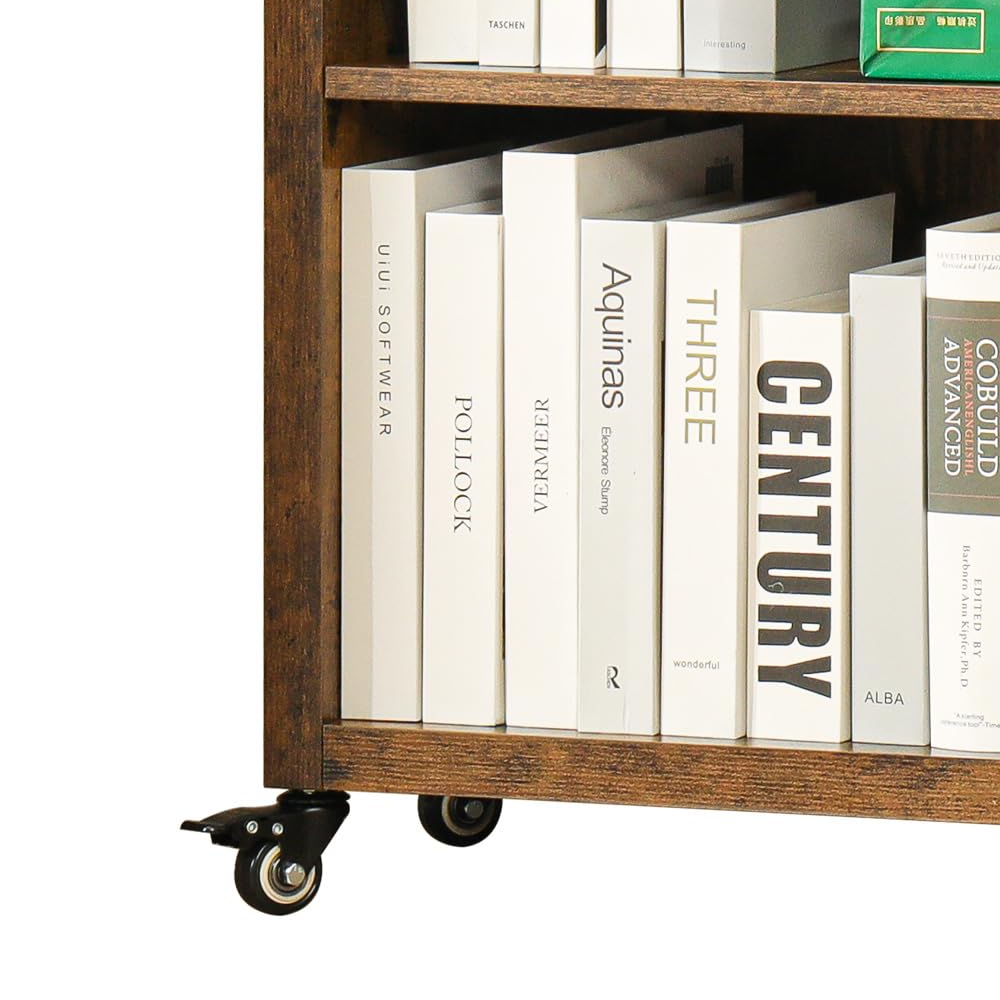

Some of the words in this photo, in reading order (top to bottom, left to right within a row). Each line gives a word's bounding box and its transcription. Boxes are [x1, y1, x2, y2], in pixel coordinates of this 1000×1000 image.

[488, 20, 525, 30] TASCHEN
[378, 244, 391, 291] UiUi
[378, 305, 392, 436] SOFTWEAR
[594, 262, 632, 409] Aquinas
[683, 289, 718, 445] THREE
[453, 395, 473, 533] POLLOCK
[533, 397, 549, 514] VERMEER
[600, 426, 613, 475] Eleonore
[943, 337, 960, 477] ADVANCED
[963, 339, 974, 476] AMERICANENGLISHL
[975, 338, 999, 478] COBUILD
[598, 479, 612, 515] Stump
[756, 360, 833, 699] CENTURY
[960, 594, 970, 617] Ann
[973, 578, 982, 632] EDITED
[973, 641, 982, 658] BY
[864, 690, 905, 705] ALBA
